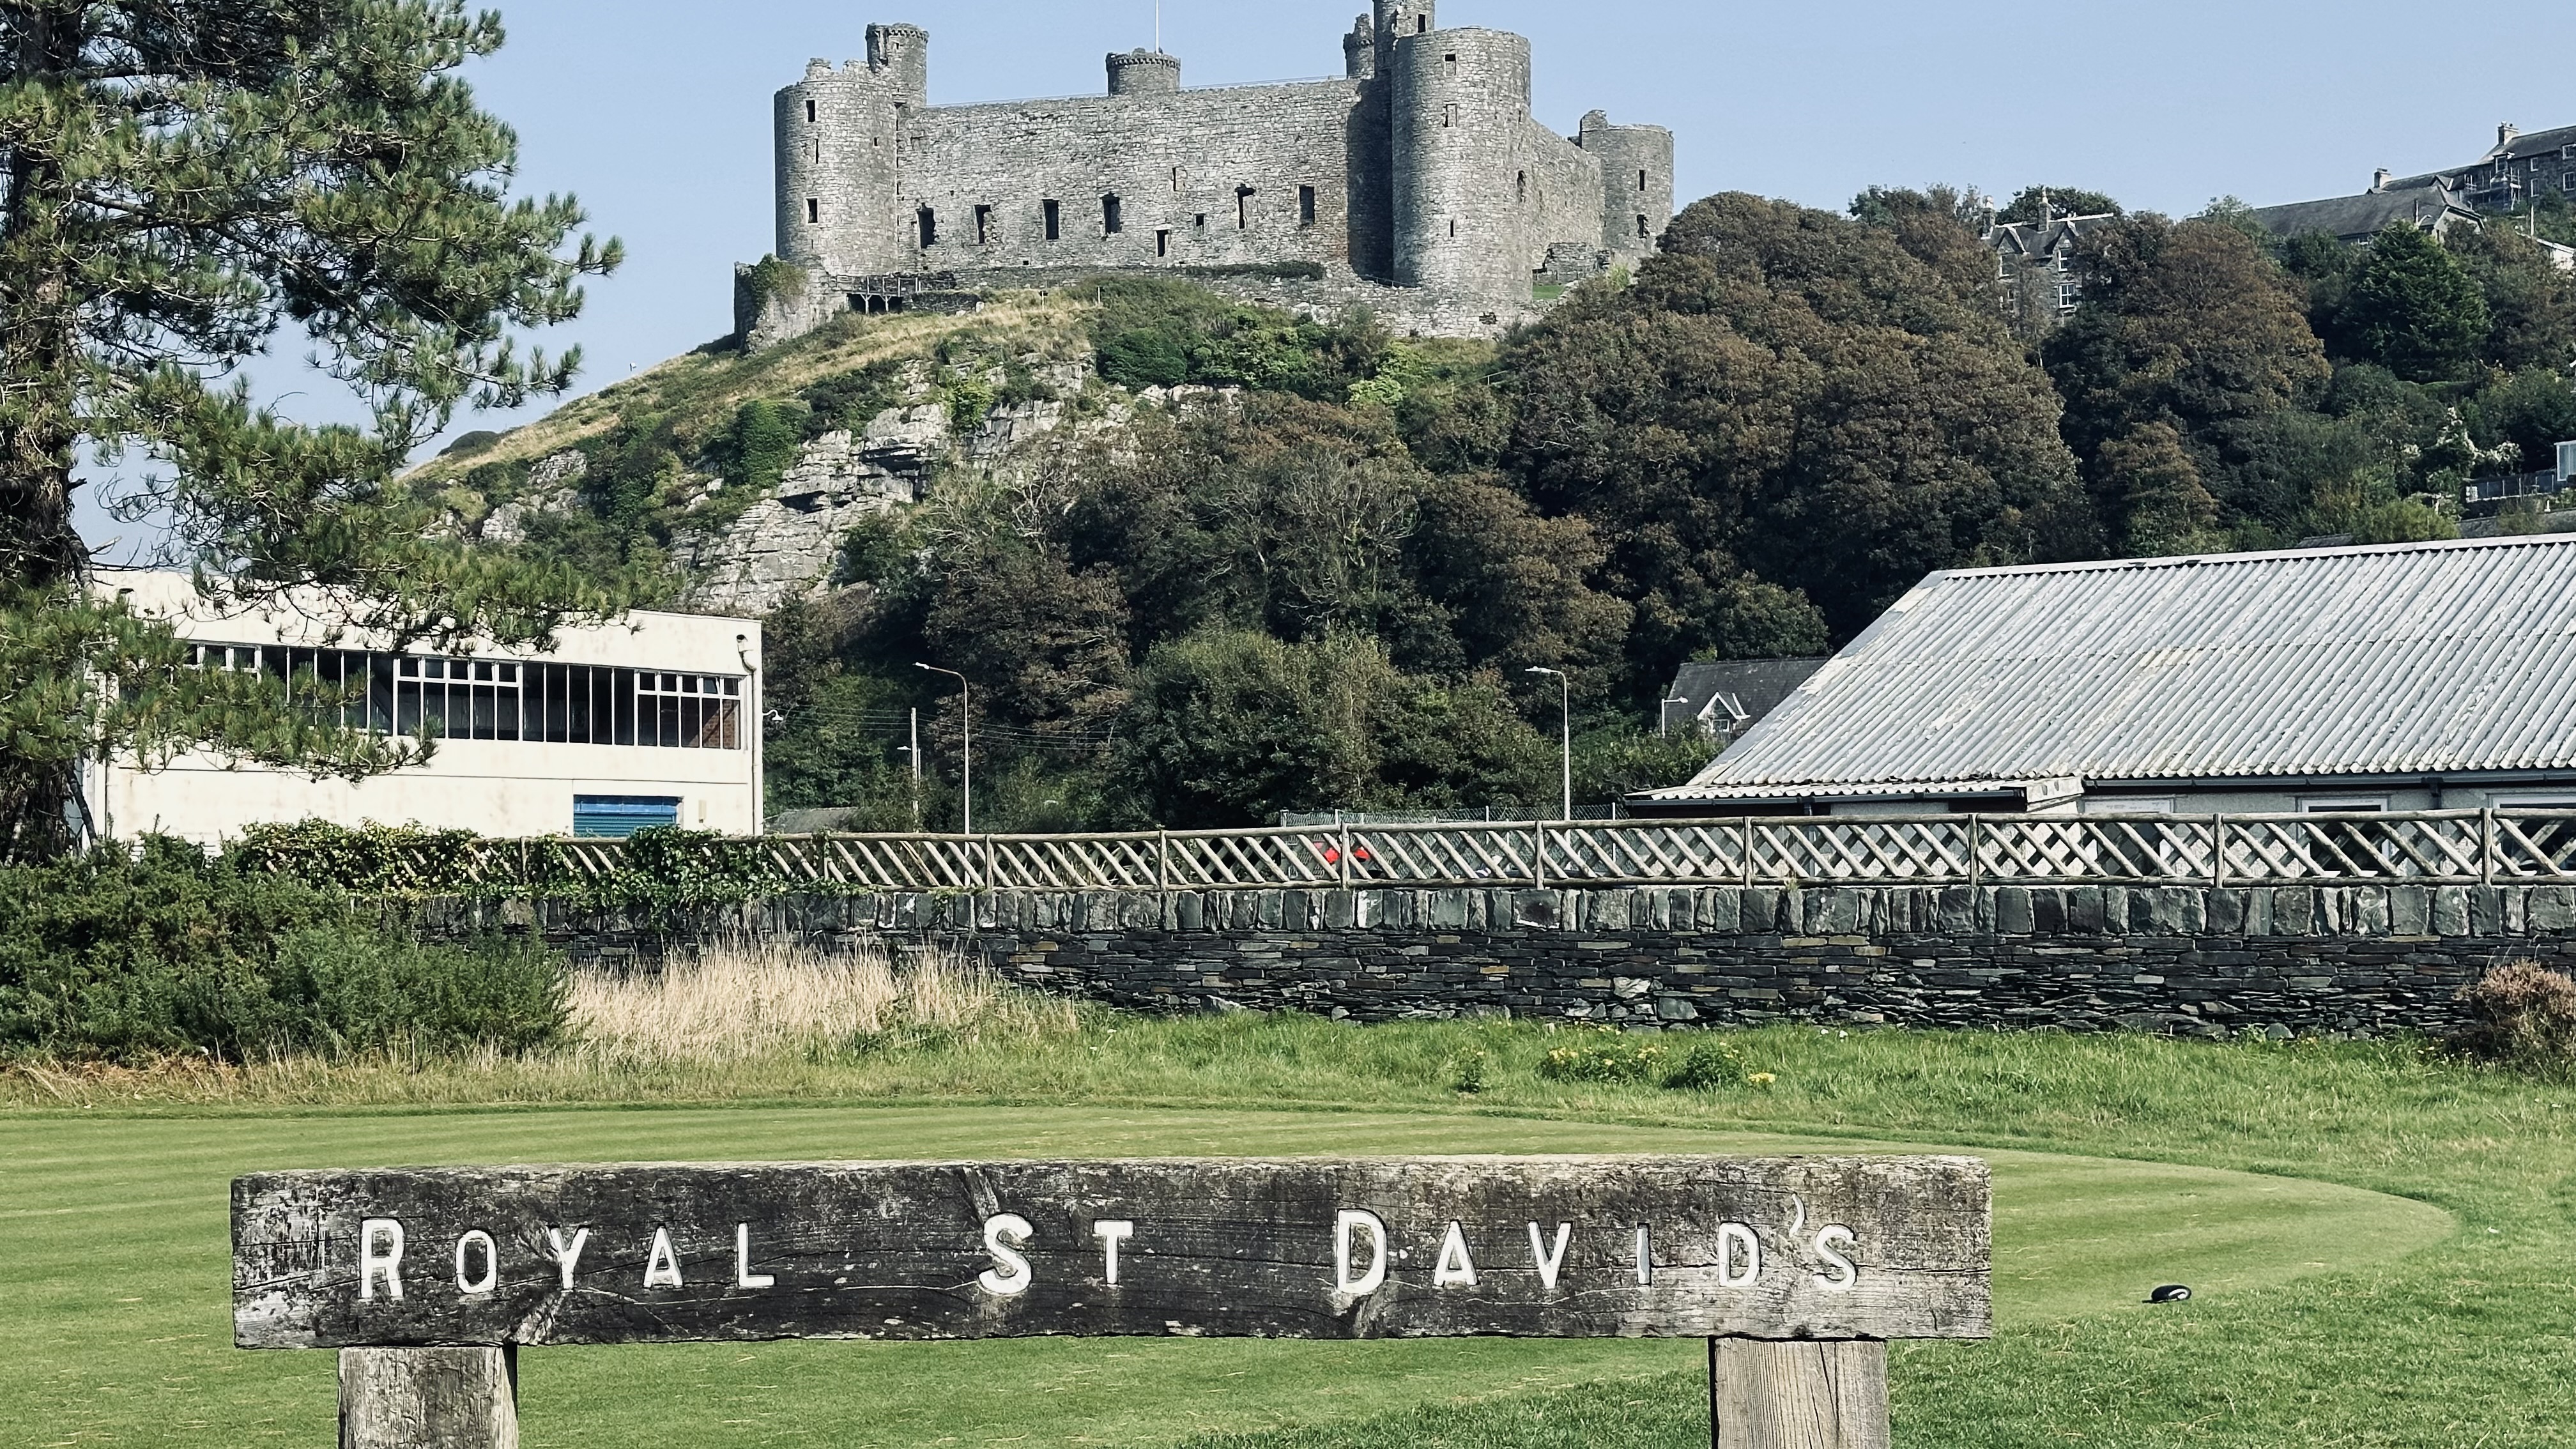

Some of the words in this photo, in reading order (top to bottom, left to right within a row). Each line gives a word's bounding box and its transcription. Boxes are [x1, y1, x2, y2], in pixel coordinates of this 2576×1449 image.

[359, 1218, 775, 1300] ROYAL
[977, 1213, 1135, 1297] ST
[1335, 1192, 1859, 1294] DAVID'S
